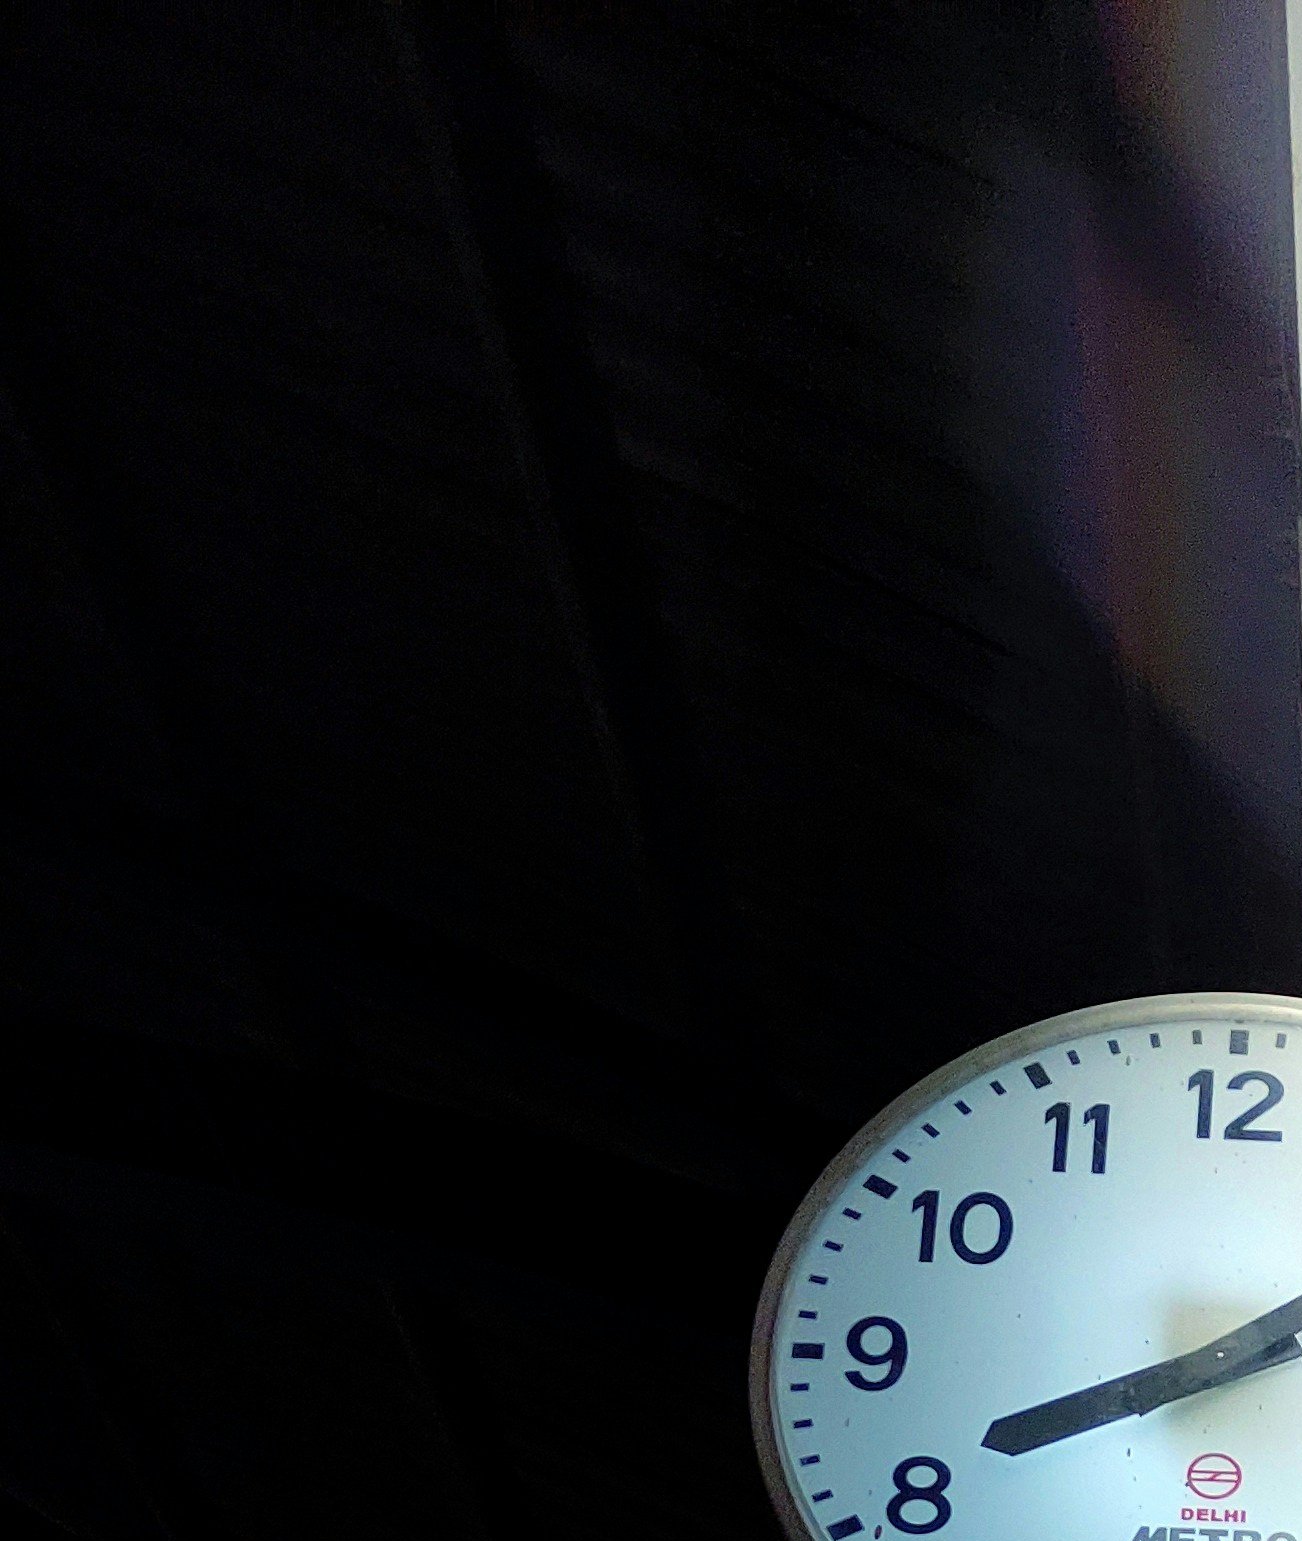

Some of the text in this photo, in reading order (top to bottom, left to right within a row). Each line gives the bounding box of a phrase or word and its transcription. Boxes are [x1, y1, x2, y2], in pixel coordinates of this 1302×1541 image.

[1045, 1101, 1111, 1174] 11
[1187, 1069, 1285, 1142] 12
[912, 1190, 1014, 1265] 10
[844, 1316, 908, 1392] 9
[886, 1456, 952, 1535] 8
[1181, 1507, 1247, 1523] DELHI
